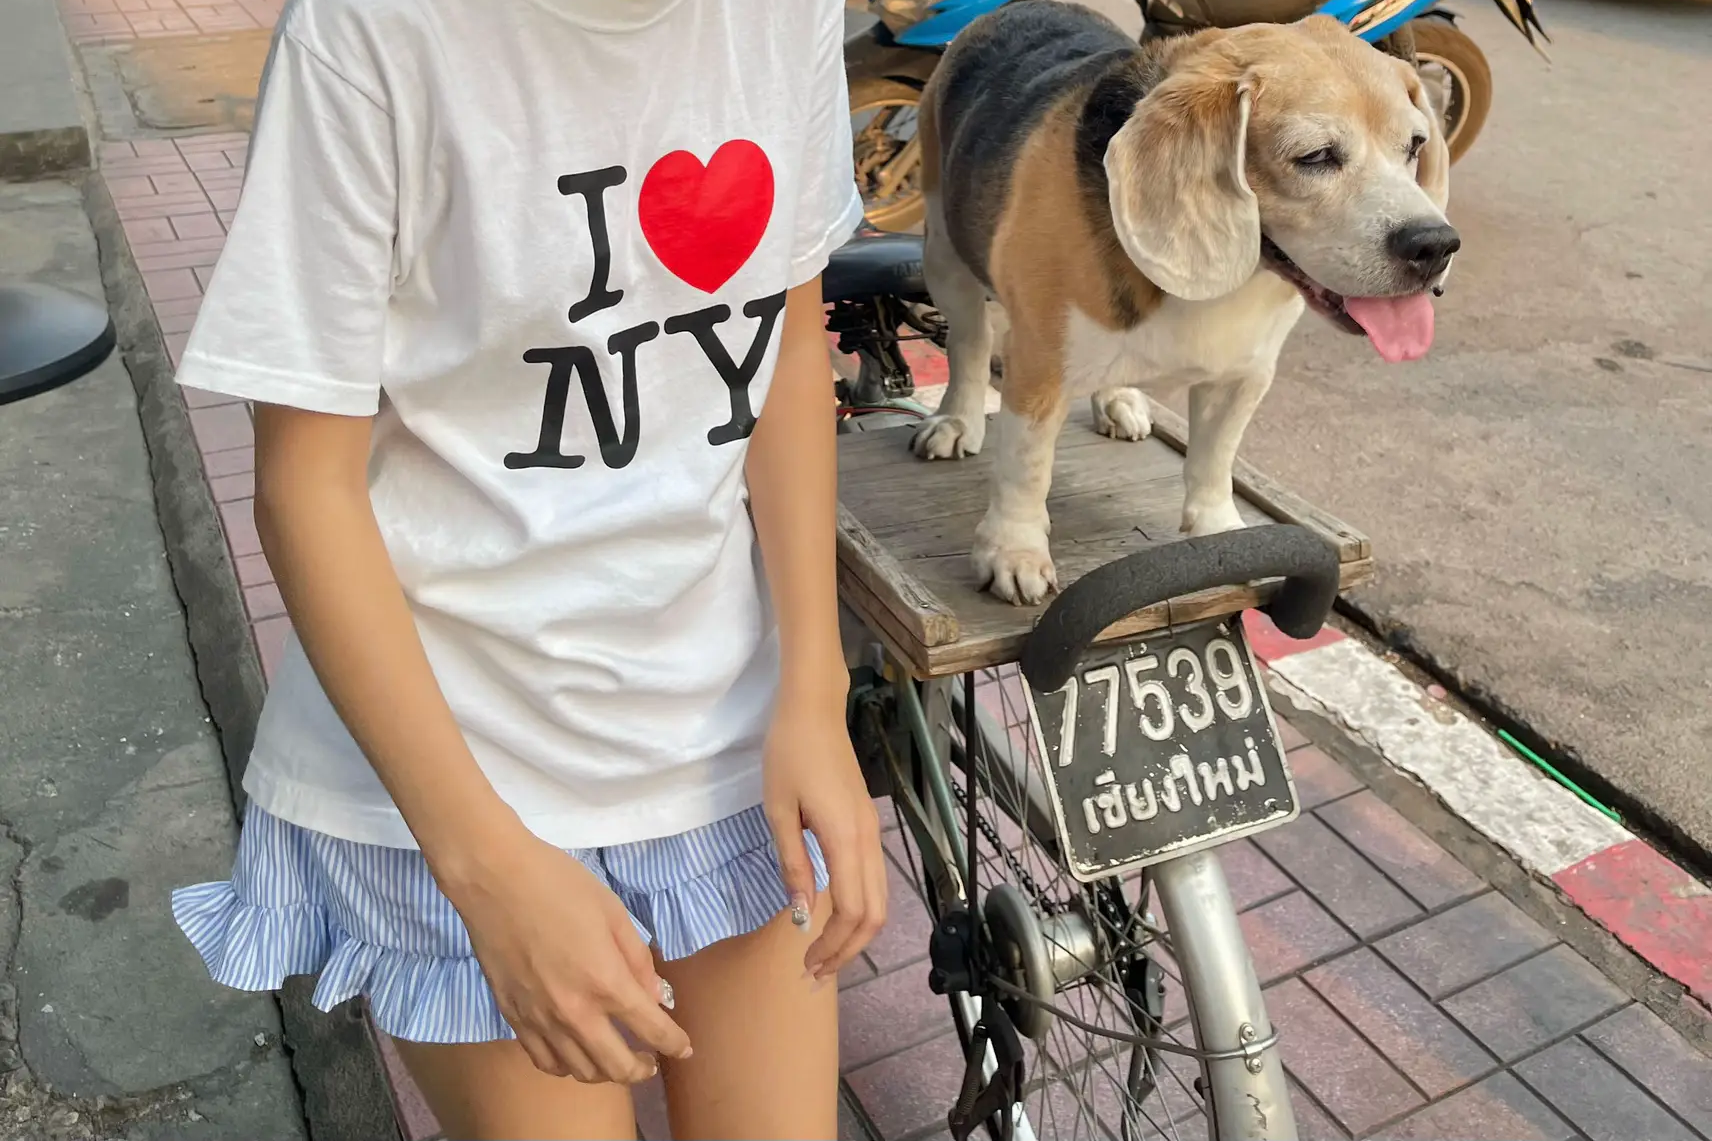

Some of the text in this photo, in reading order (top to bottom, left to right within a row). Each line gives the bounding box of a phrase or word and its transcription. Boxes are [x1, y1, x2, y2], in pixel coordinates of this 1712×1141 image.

[557, 165, 628, 324] I
[503, 288, 788, 470] NY
[1043, 638, 1253, 767] 77539
[1082, 736, 1266, 834] เชียงใหม่
